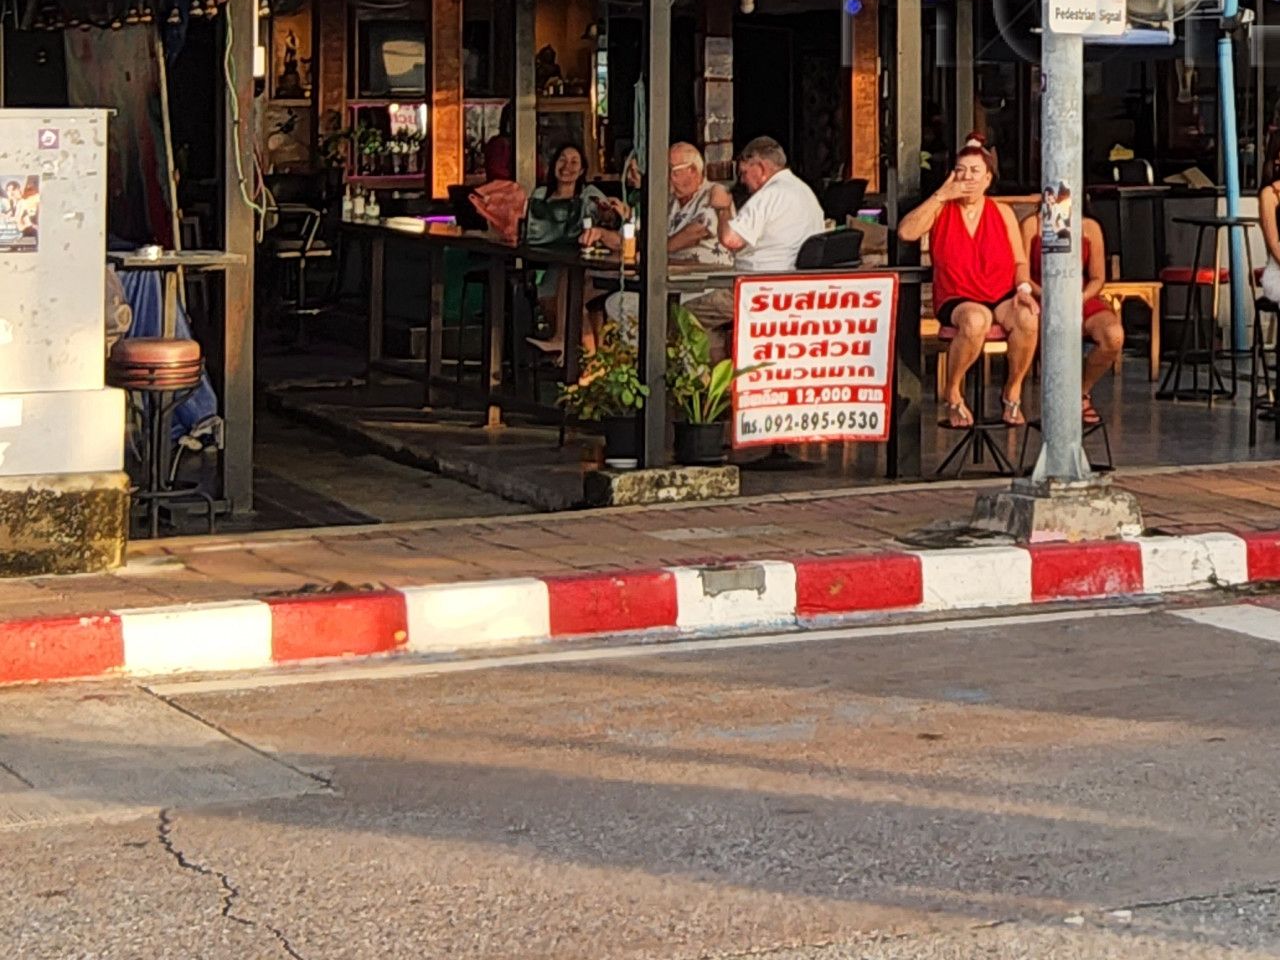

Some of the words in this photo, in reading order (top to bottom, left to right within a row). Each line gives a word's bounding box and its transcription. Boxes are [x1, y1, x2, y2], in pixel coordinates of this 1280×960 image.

[1055, 6, 1096, 21] Pedestrian
[1099, 8, 1122, 24] Signal
[750, 285, 882, 313] รับสมัคร
[750, 314, 878, 338] พนักงาน
[753, 339, 871, 360] สาวสวย
[796, 387, 851, 406] 12,000
